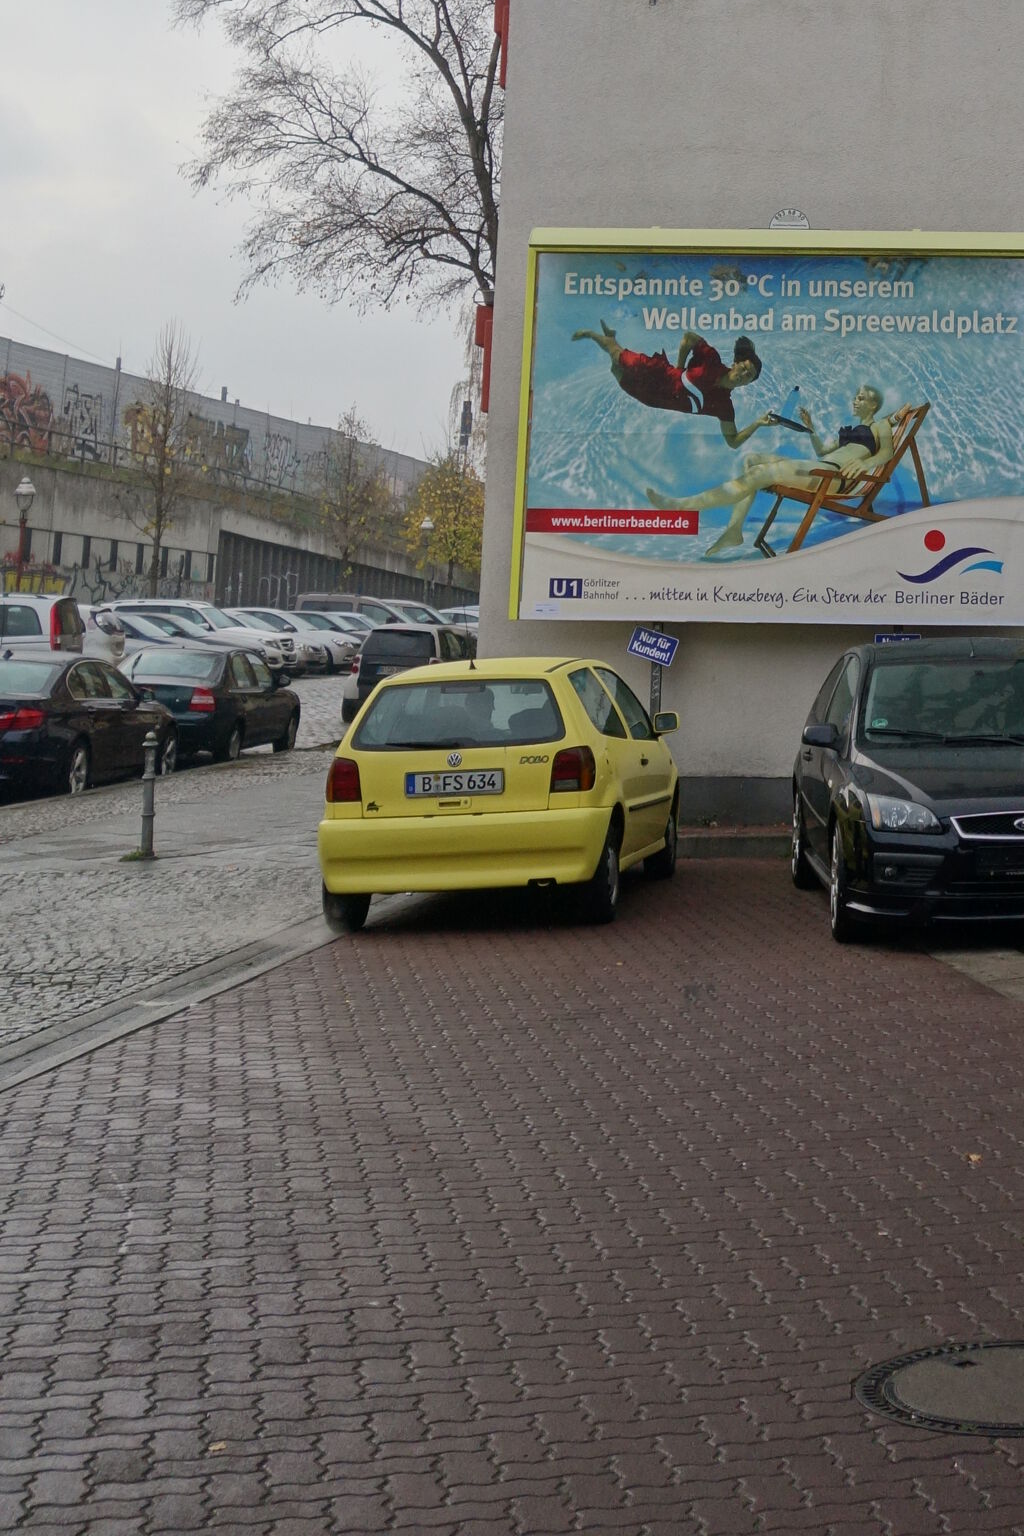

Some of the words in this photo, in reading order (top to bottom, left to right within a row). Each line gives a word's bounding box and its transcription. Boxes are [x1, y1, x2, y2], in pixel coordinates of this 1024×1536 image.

[564, 272, 704, 301] Entspannte
[708, 279, 741, 302] 30
[781, 274, 801, 297] in
[808, 279, 915, 298] unserem
[642, 307, 774, 331] Wellenbad
[781, 312, 817, 332] am
[823, 309, 1018, 338] Spreewaldplatz
[551, 515, 690, 529] www.berlinerbaeder.de
[552, 579, 580, 598] U1
[583, 578, 621, 588] Görlitzer
[583, 591, 619, 600] Bahnhof
[697, 588, 709, 601] in
[713, 585, 789, 609] Kreuzberg.
[792, 587, 818, 604] Ein
[821, 586, 862, 604] Stern
[863, 589, 887, 604] der
[895, 591, 955, 605] Berliner
[960, 591, 1005, 605] Bäder
[639, 631, 657, 645] Nur
[656, 637, 671, 650] für
[631, 640, 671, 662] Kunden!
[422, 777, 432, 792] B
[442, 775, 463, 791] FS
[467, 773, 497, 790] 634
